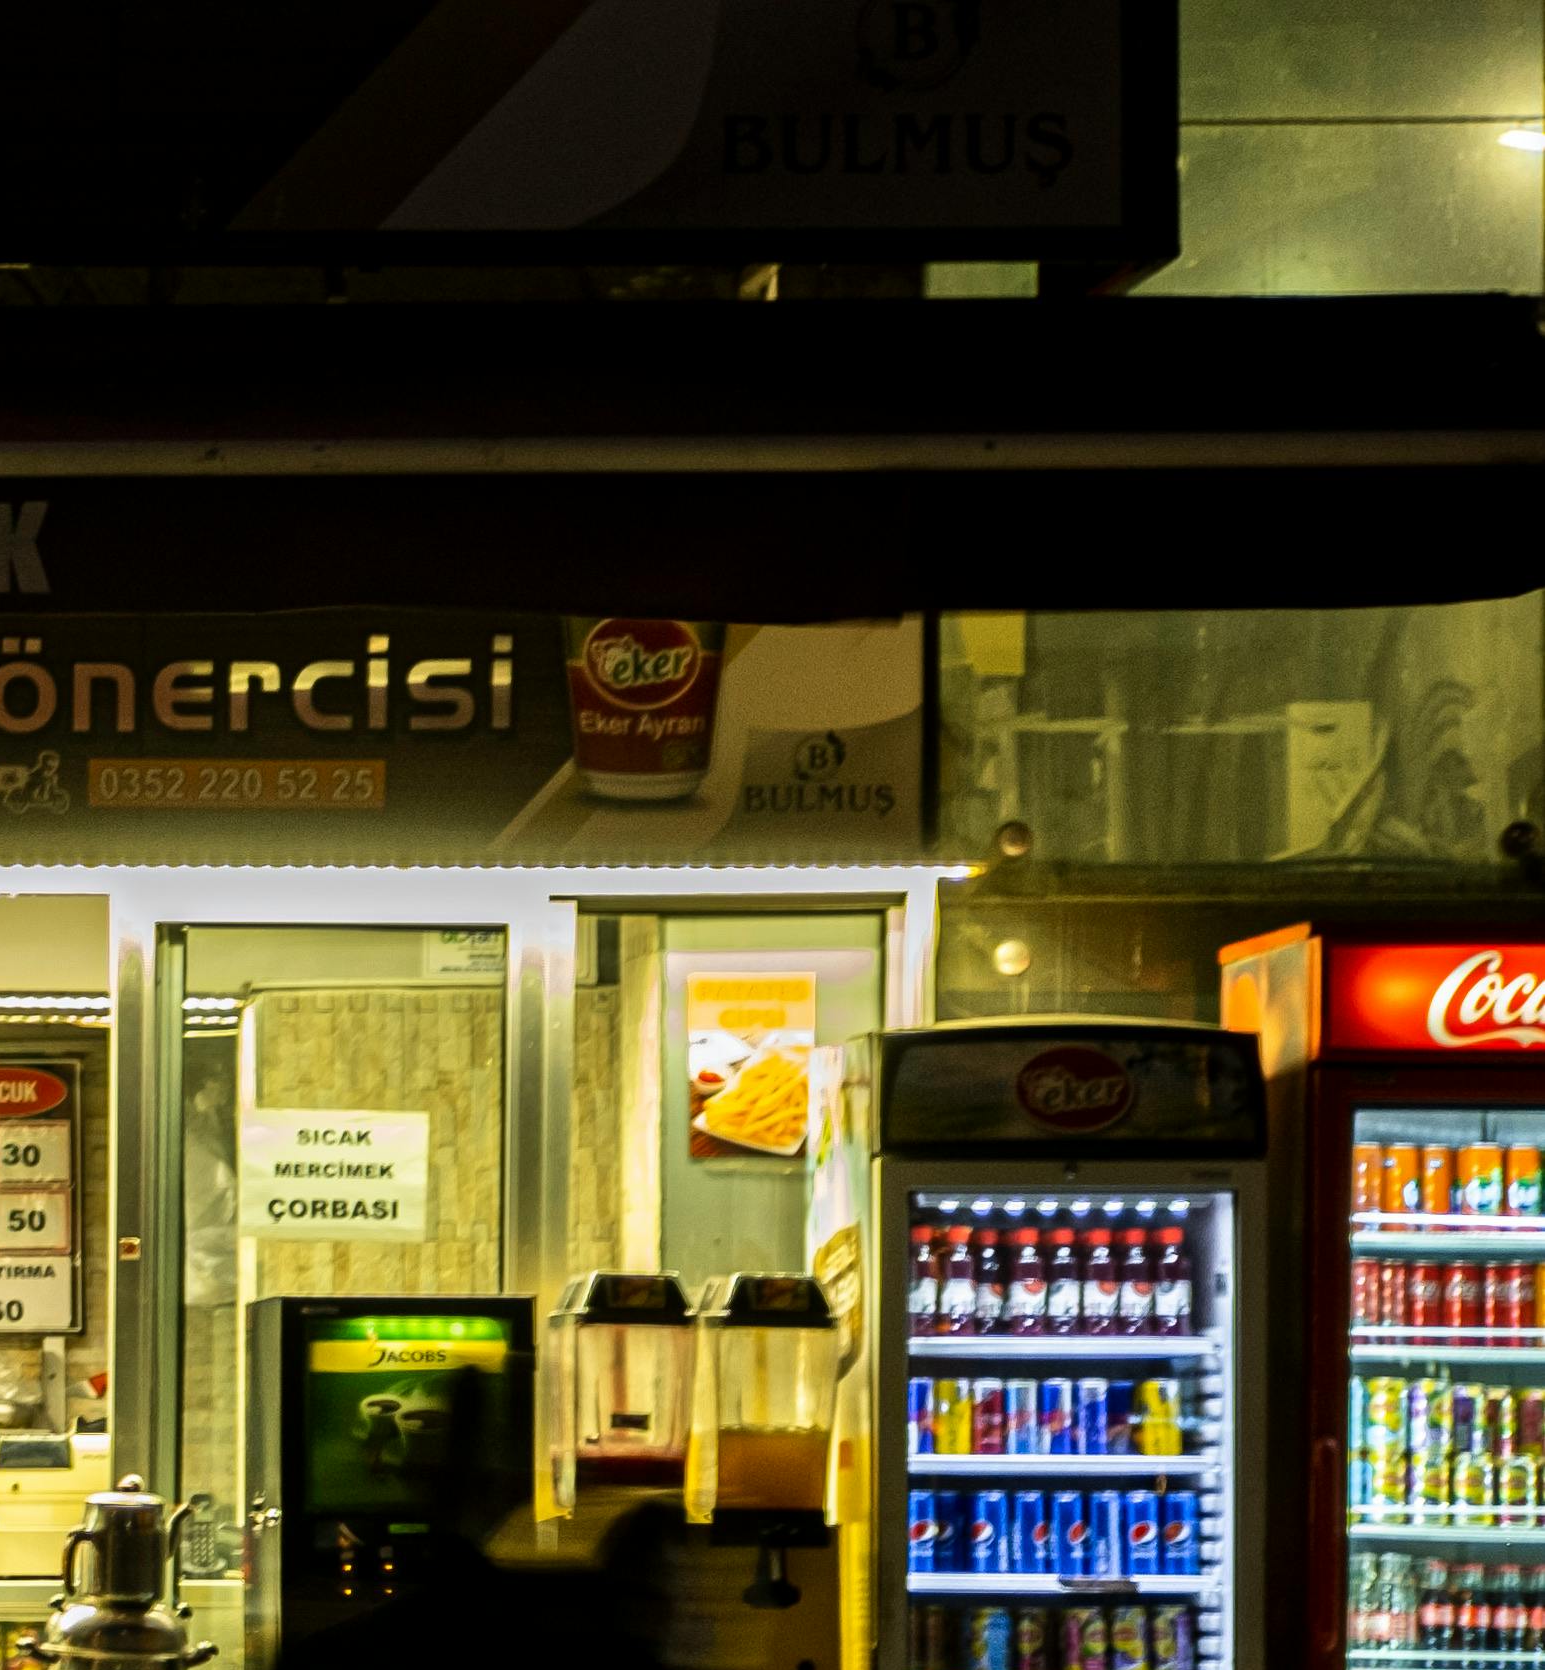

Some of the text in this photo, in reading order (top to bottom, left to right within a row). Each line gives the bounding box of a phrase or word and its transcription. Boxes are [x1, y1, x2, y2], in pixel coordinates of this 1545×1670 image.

[723, 113, 1074, 187] BULMUŞ
[611, 638, 690, 688] eker
[579, 713, 706, 741] Eker Ayran
[98, 766, 375, 800] 0352 220 52 25
[742, 784, 896, 817] BULMUŞ
[296, 1129, 373, 1146] SICAK
[2, 1143, 41, 1167] 30
[274, 1158, 394, 1179] MERCİMEK
[7, 1209, 46, 1232] 50
[267, 1198, 399, 1224] ÇORBASI
[369, 1349, 447, 1367] JACOBS
